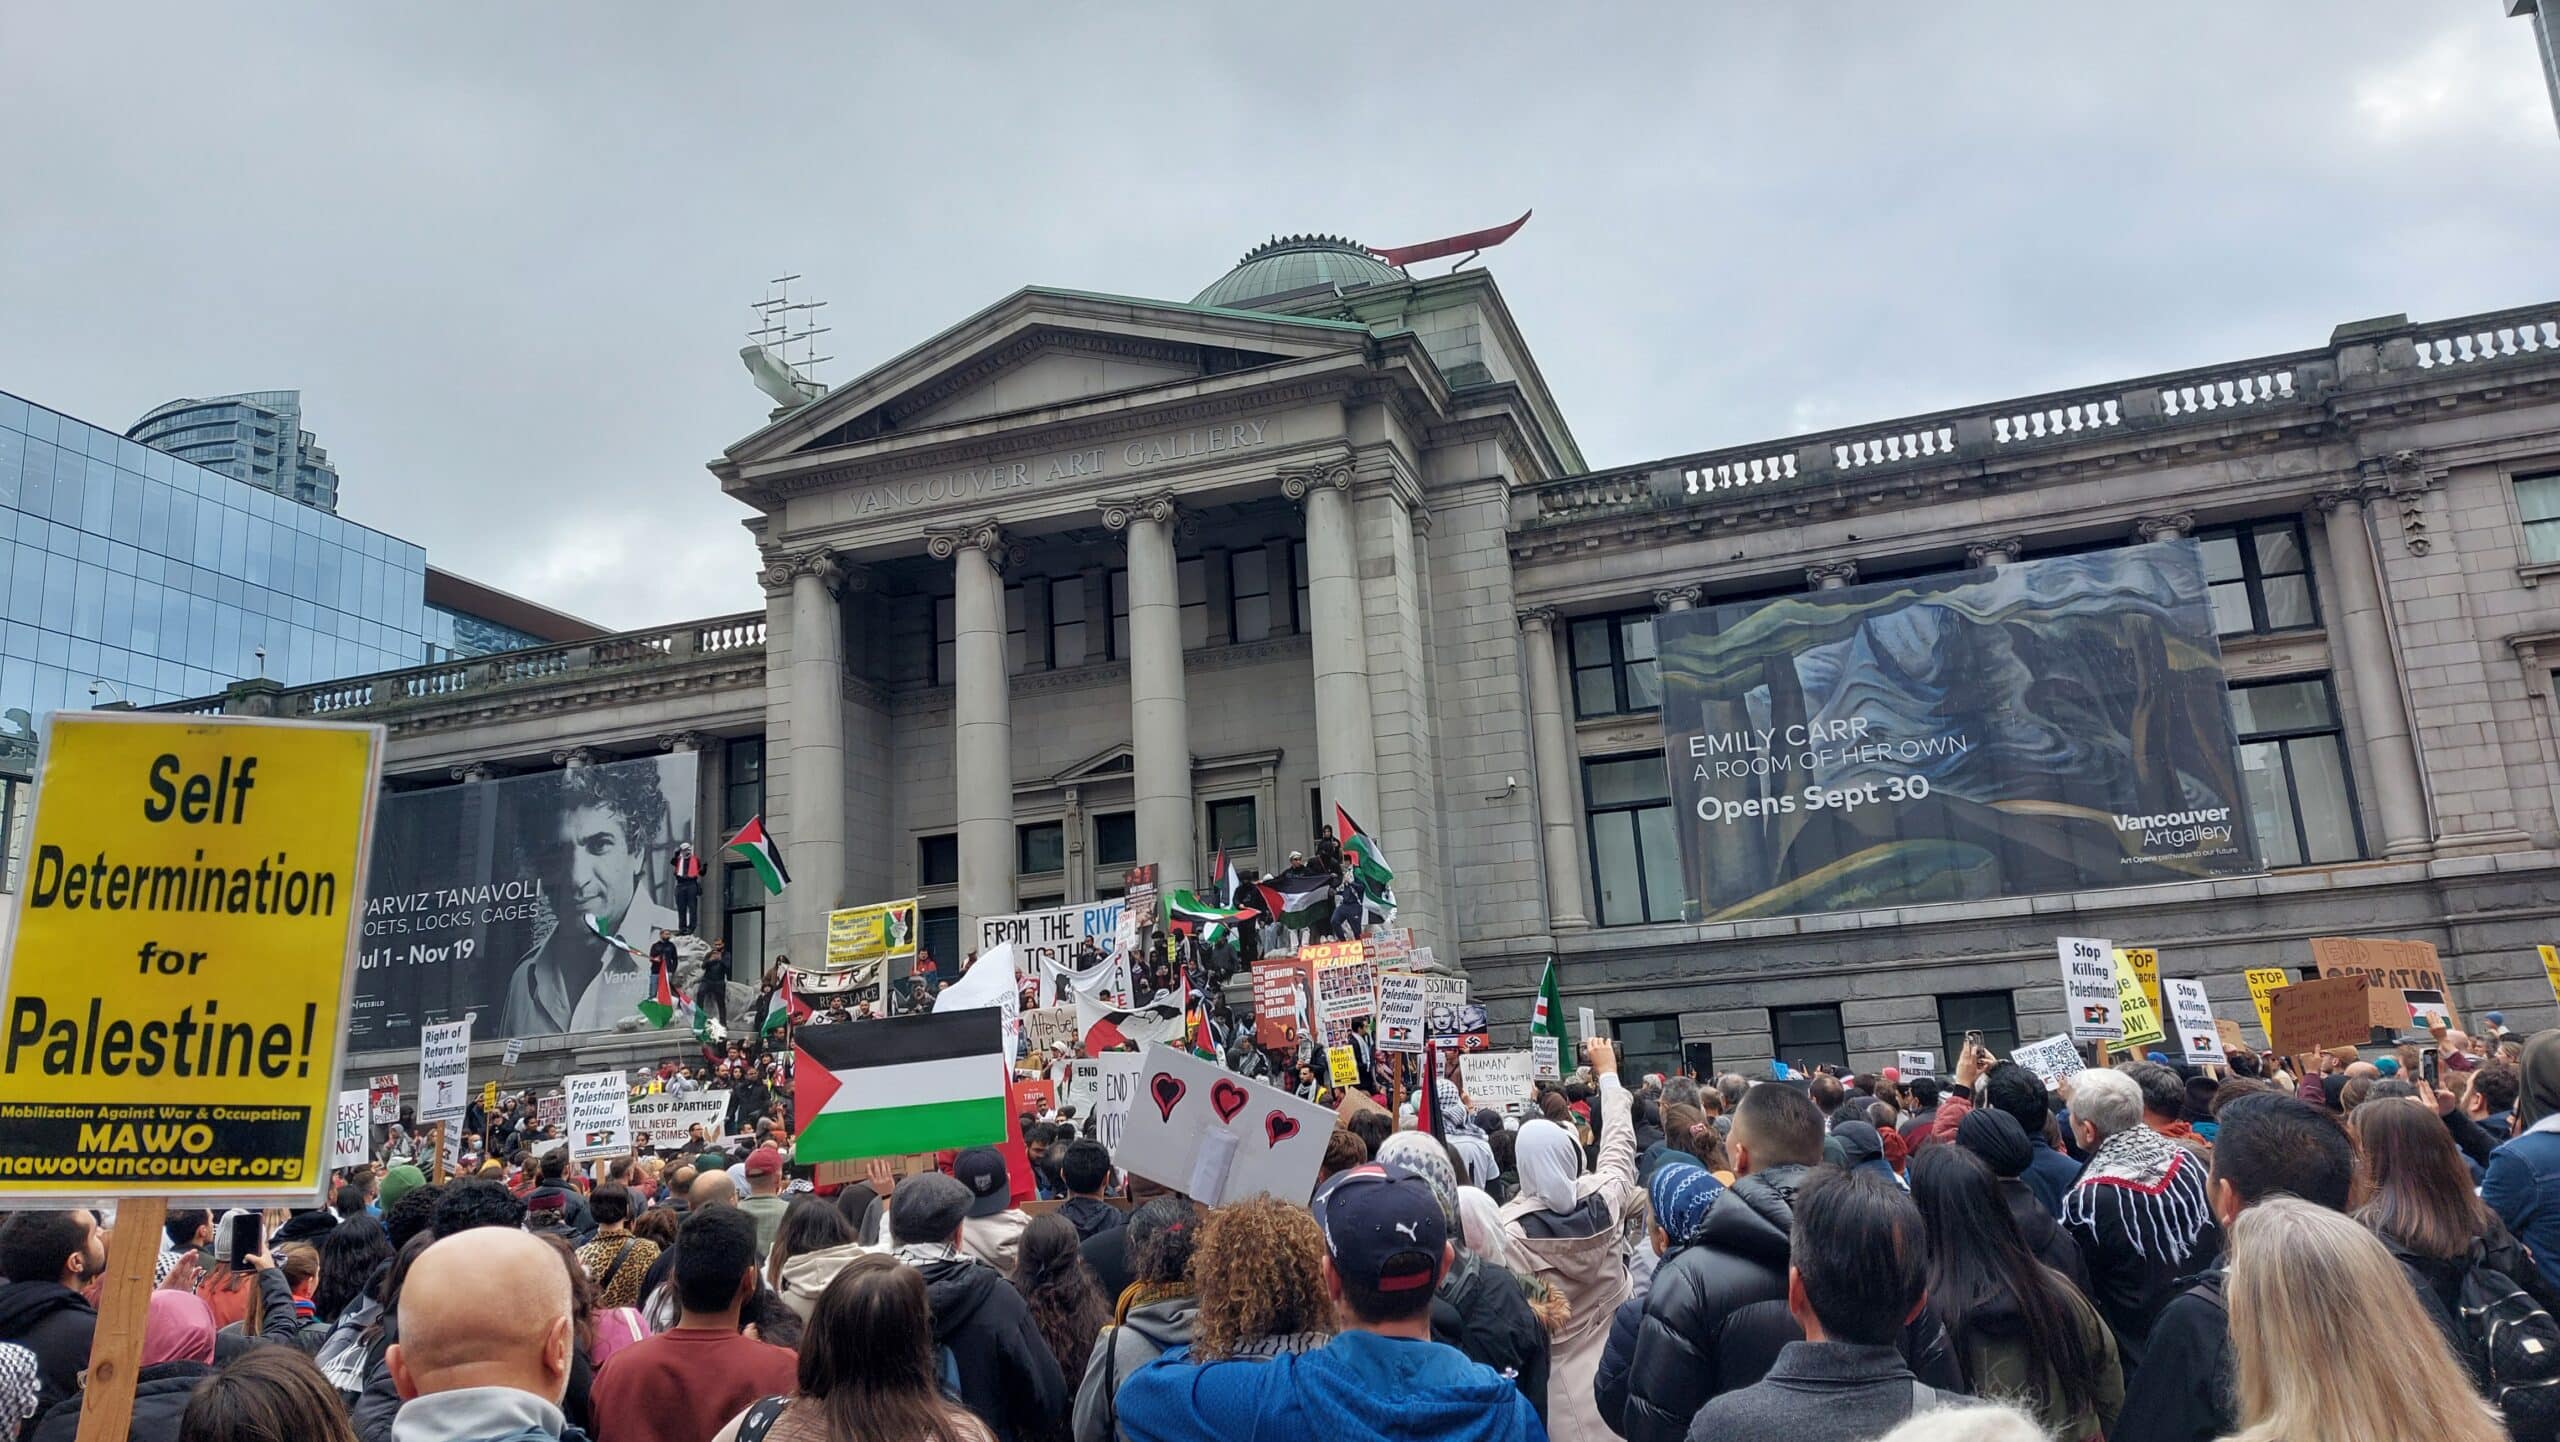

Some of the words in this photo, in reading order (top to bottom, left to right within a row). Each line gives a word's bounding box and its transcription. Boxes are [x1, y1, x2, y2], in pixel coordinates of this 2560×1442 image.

[849, 463, 1031, 514] VANCOUVER
[1045, 450, 1104, 481] ART
[1123, 420, 1270, 468] GALLERY
[1689, 727, 1776, 757] EMILY
[1785, 717, 1869, 746] CARR
[1693, 764, 1710, 782] A
[1716, 754, 1792, 779] ROOM
[1800, 749, 1833, 770] OF
[1842, 743, 1892, 765] HER
[1900, 734, 1968, 759] OWN
[144, 753, 257, 825] Self
[1696, 795, 1796, 824] Opens
[1803, 782, 1881, 812] Sept
[1888, 774, 1930, 802] 30
[2112, 807, 2230, 831] Vancouver
[31, 845, 336, 917] Determination
[435, 878, 541, 908] TANAVOLI
[362, 919, 411, 937] OETS,
[416, 911, 475, 931] LOCKS,
[481, 903, 539, 923] CAGES
[984, 918, 1030, 948] FROM
[1040, 913, 1075, 942] THE
[1083, 905, 1125, 937] RIVE
[138, 941, 207, 975] for
[383, 947, 391, 967] 1
[409, 945, 449, 965] Nov
[453, 938, 475, 959] 19
[1302, 946, 1331, 960] NO
[1337, 942, 1363, 956] TO
[2074, 942, 2101, 961] Stop
[2322, 940, 2370, 966] END
[2126, 953, 2153, 968] TOP
[2072, 962, 2109, 980] Killing
[2136, 973, 2157, 983] acre
[2249, 971, 2283, 985] STOP
[1382, 976, 1402, 988] Free
[1404, 978, 1418, 989] All
[1425, 978, 1464, 994] SISTANCE
[2069, 980, 2118, 999] Palestinians!
[819, 987, 878, 1008] RESTANCE
[1381, 987, 1423, 1002] Palestinian
[2176, 983, 2198, 1000] Stop
[2253, 989, 2271, 1000] U.S
[1380, 1001, 1414, 1013] Political
[2120, 996, 2147, 1013] aza
[2178, 1000, 2206, 1014] Killing
[1380, 1013, 1422, 1026] Prisoners!
[2123, 1013, 2149, 1035] OW!
[5, 996, 317, 1079] Palestine!
[425, 1029, 449, 1044] Right
[452, 1025, 462, 1038] of
[424, 1046, 453, 1059] Return
[455, 1043, 468, 1053] for
[1910, 1056, 1926, 1064] FREE
[423, 1058, 468, 1080] Palestinians!
[1078, 1066, 1098, 1077] END
[1485, 1074, 1508, 1082] STAND
[1511, 1072, 1531, 1082] WITH
[571, 1079, 597, 1090] Free
[600, 1075, 617, 1087] All
[1106, 1072, 1128, 1102] END
[1468, 1084, 1523, 1097] PALESTINE
[571, 1089, 626, 1104] Palestinian
[1, 1105, 94, 1120] Mobilization
[98, 1107, 154, 1121] Against
[160, 1107, 192, 1120] War
[196, 1108, 209, 1120] &
[213, 1108, 300, 1122] Occupation
[337, 1103, 364, 1120] EASE
[573, 1103, 614, 1117] Political
[629, 1103, 655, 1114] EARS
[657, 1102, 669, 1113] OF
[671, 1101, 722, 1112] APARTHEID
[336, 1119, 361, 1138] FIRE
[573, 1116, 626, 1131] Prisoners!
[649, 1118, 678, 1129] NEVER
[77, 1123, 214, 1153] MAWO
[655, 1129, 689, 1140] CRIMES
[335, 1136, 363, 1154] NOW
